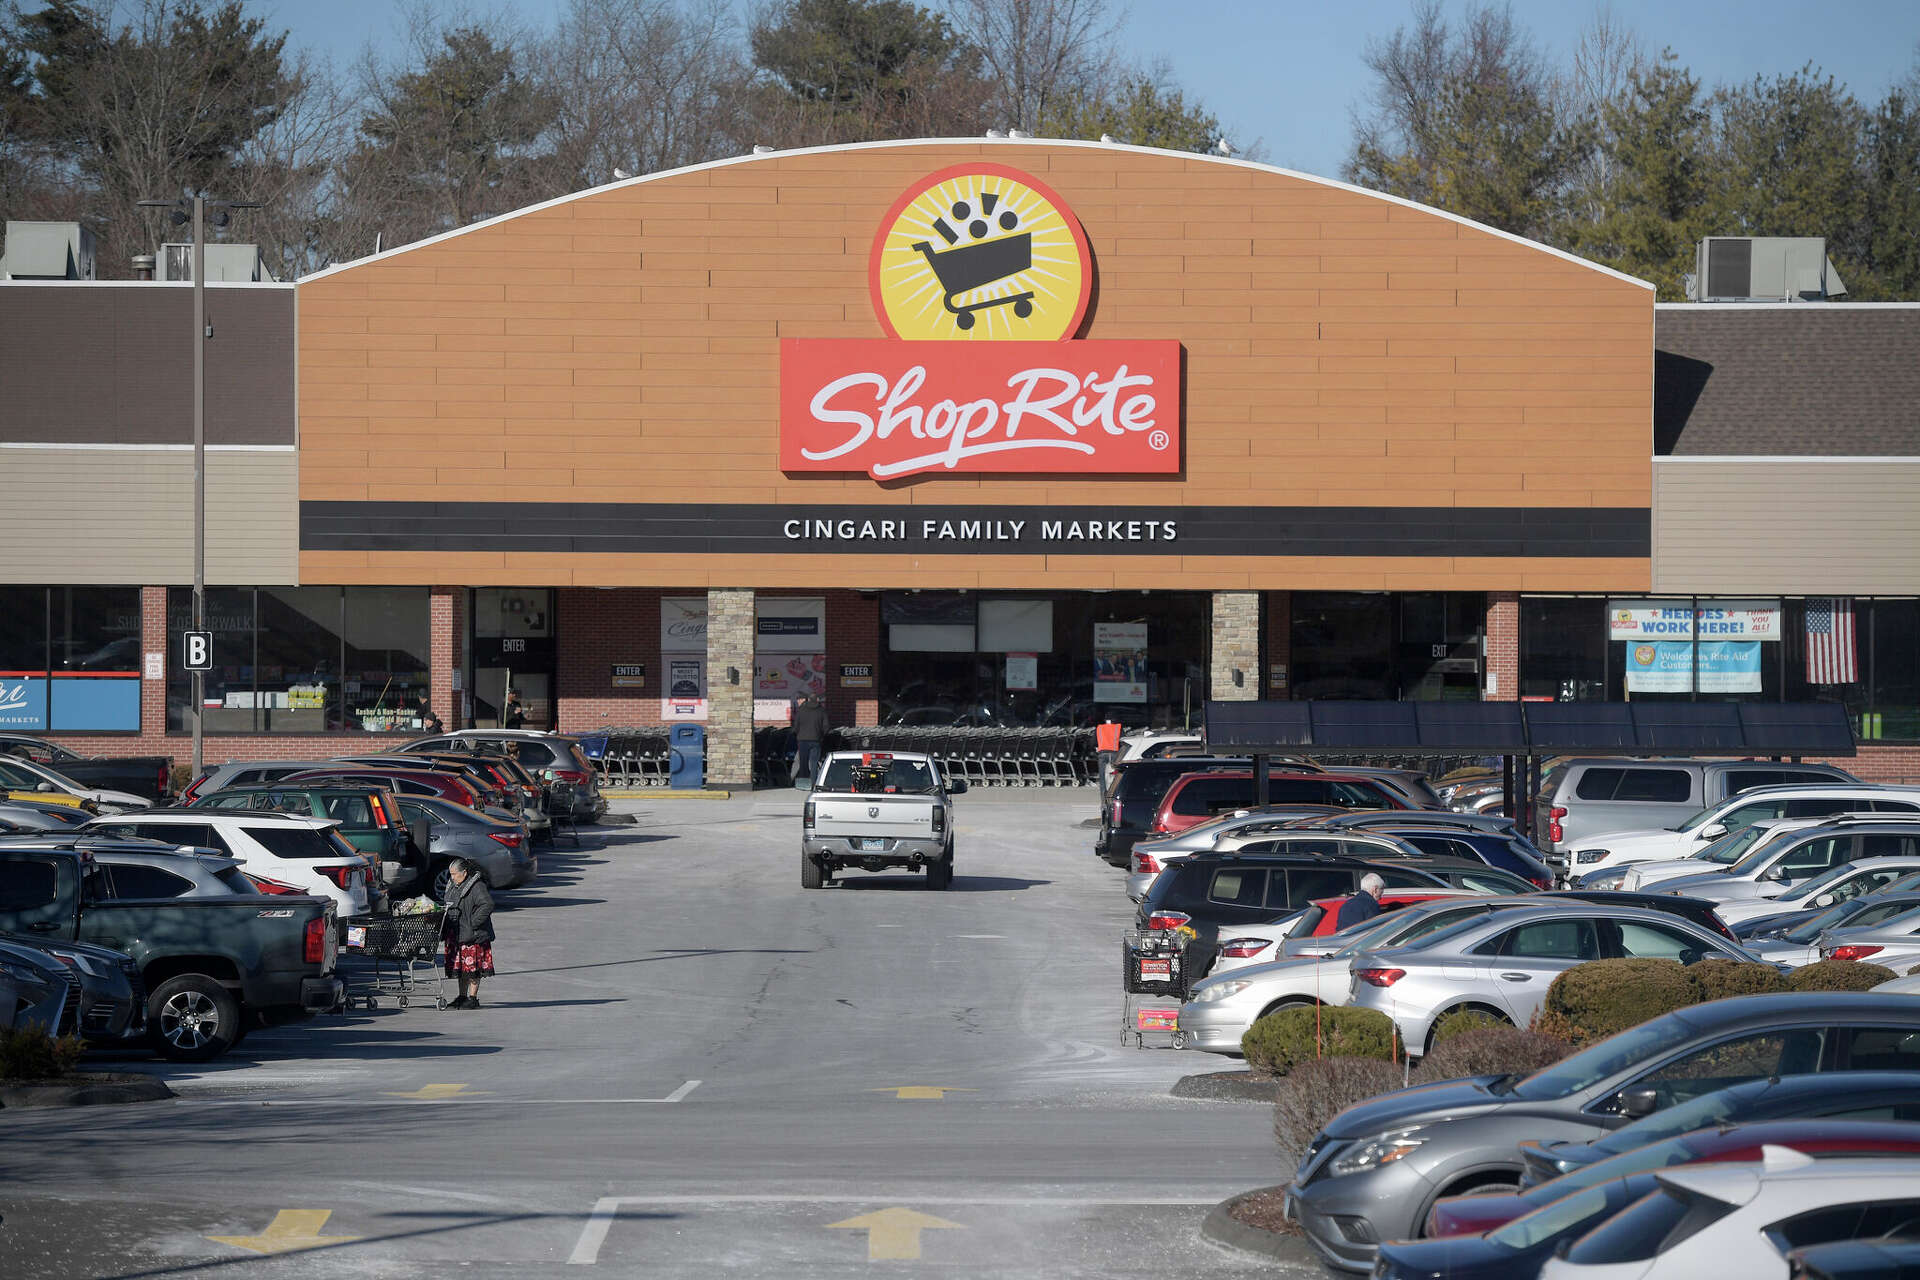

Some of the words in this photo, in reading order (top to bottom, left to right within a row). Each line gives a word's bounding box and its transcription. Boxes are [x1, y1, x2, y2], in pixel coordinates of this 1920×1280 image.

[801, 365, 1156, 469] ShopRite
[783, 519, 906, 540] CINGARI
[923, 520, 1026, 540] FAMILY
[1041, 520, 1178, 541] MARKETS
[1662, 608, 1724, 619] HEROES
[203, 616, 252, 629] ORWALK
[1641, 621, 1690, 633] WORK
[1697, 621, 1744, 633] HERE!
[189, 636, 206, 665] B
[502, 639, 525, 652] ENTER
[1432, 645, 1447, 657] EXIT
[1711, 651, 1729, 661] Rite
[1732, 651, 1748, 661] Aid
[616, 666, 640, 675] ENTER
[844, 667, 868, 676] ENTER
